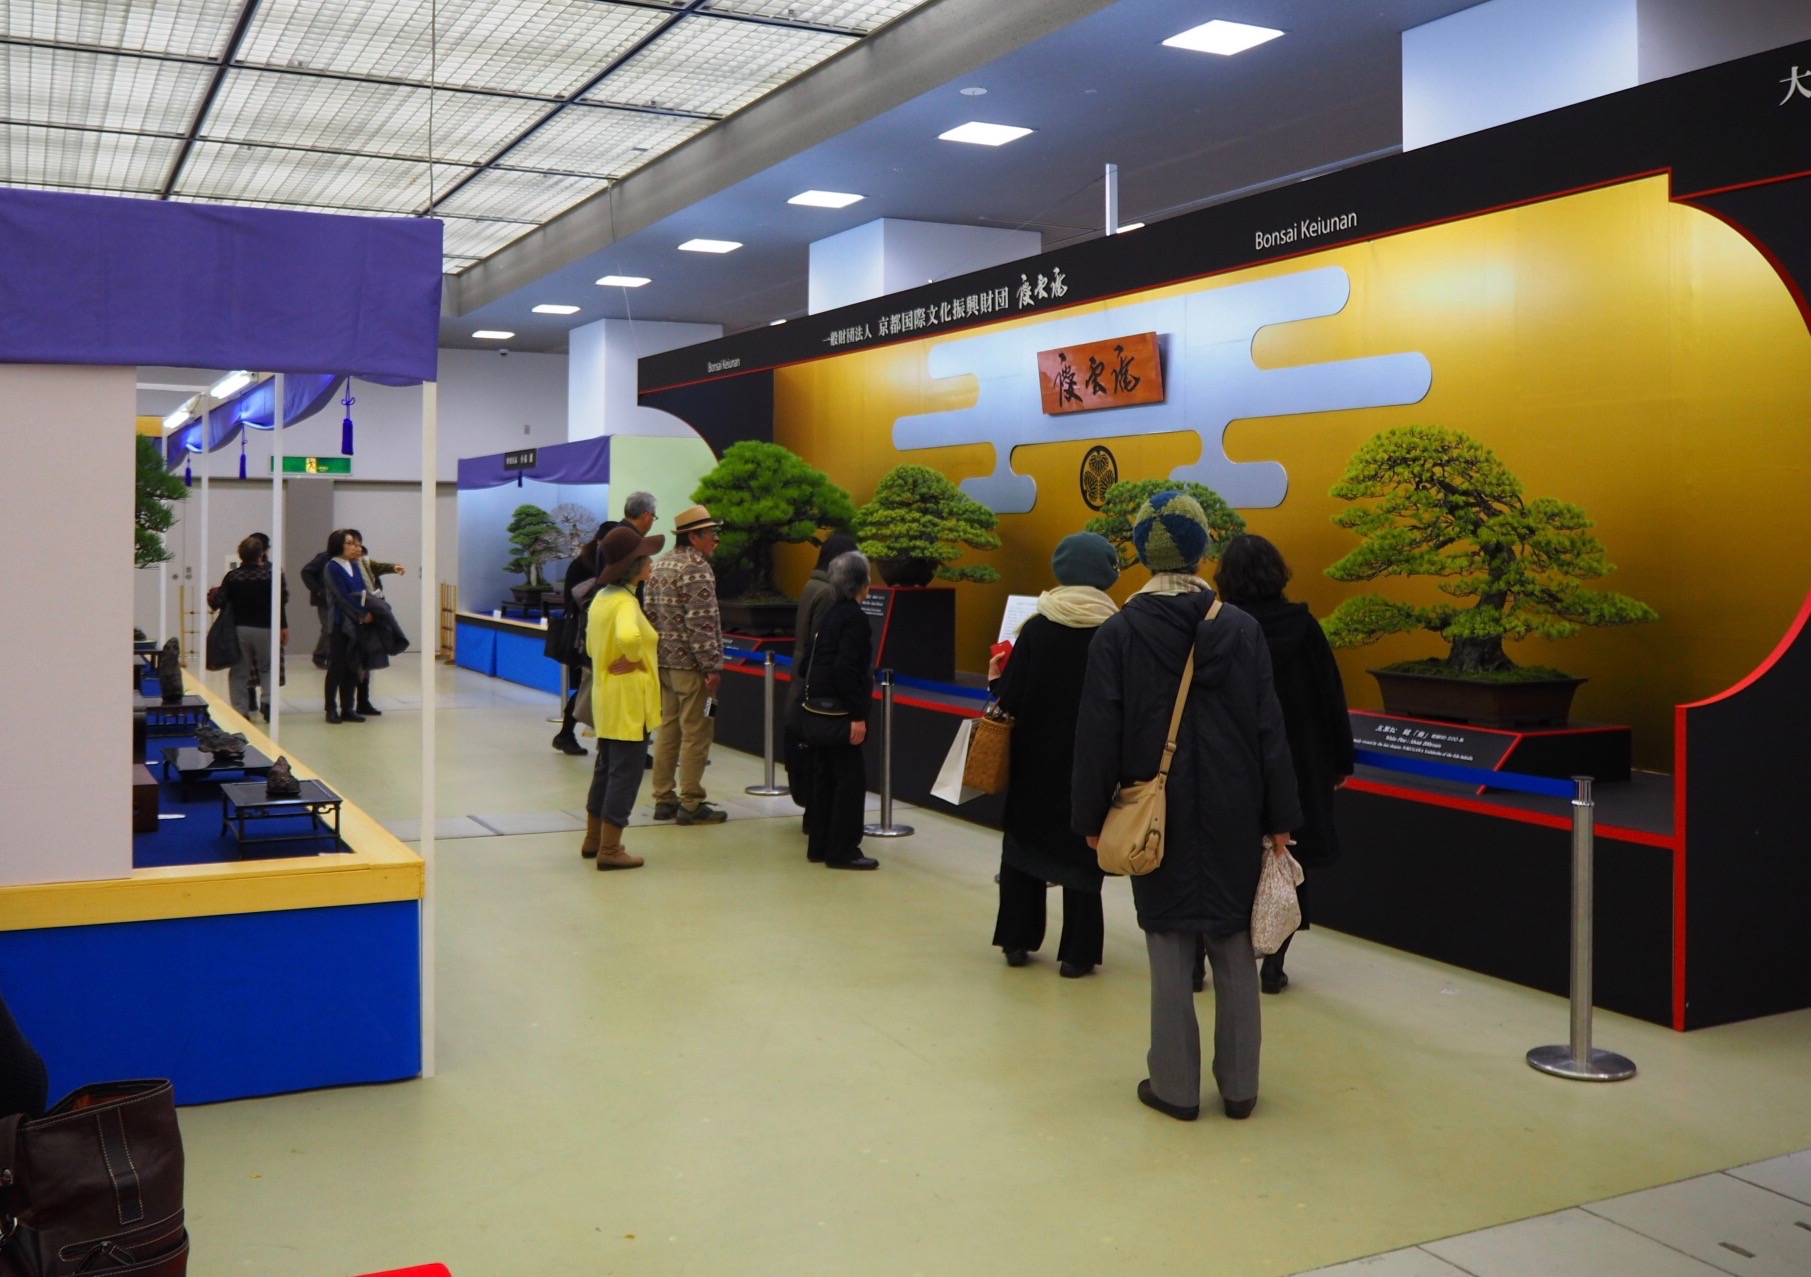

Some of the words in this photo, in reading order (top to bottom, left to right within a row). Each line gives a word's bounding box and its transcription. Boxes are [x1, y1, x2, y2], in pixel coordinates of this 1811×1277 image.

[1255, 222, 1298, 250] Bonsai
[1301, 211, 1358, 239] Keiunan
[822, 323, 873, 347] 一般財団法人
[878, 287, 1009, 337] 京都国際文化振興財団
